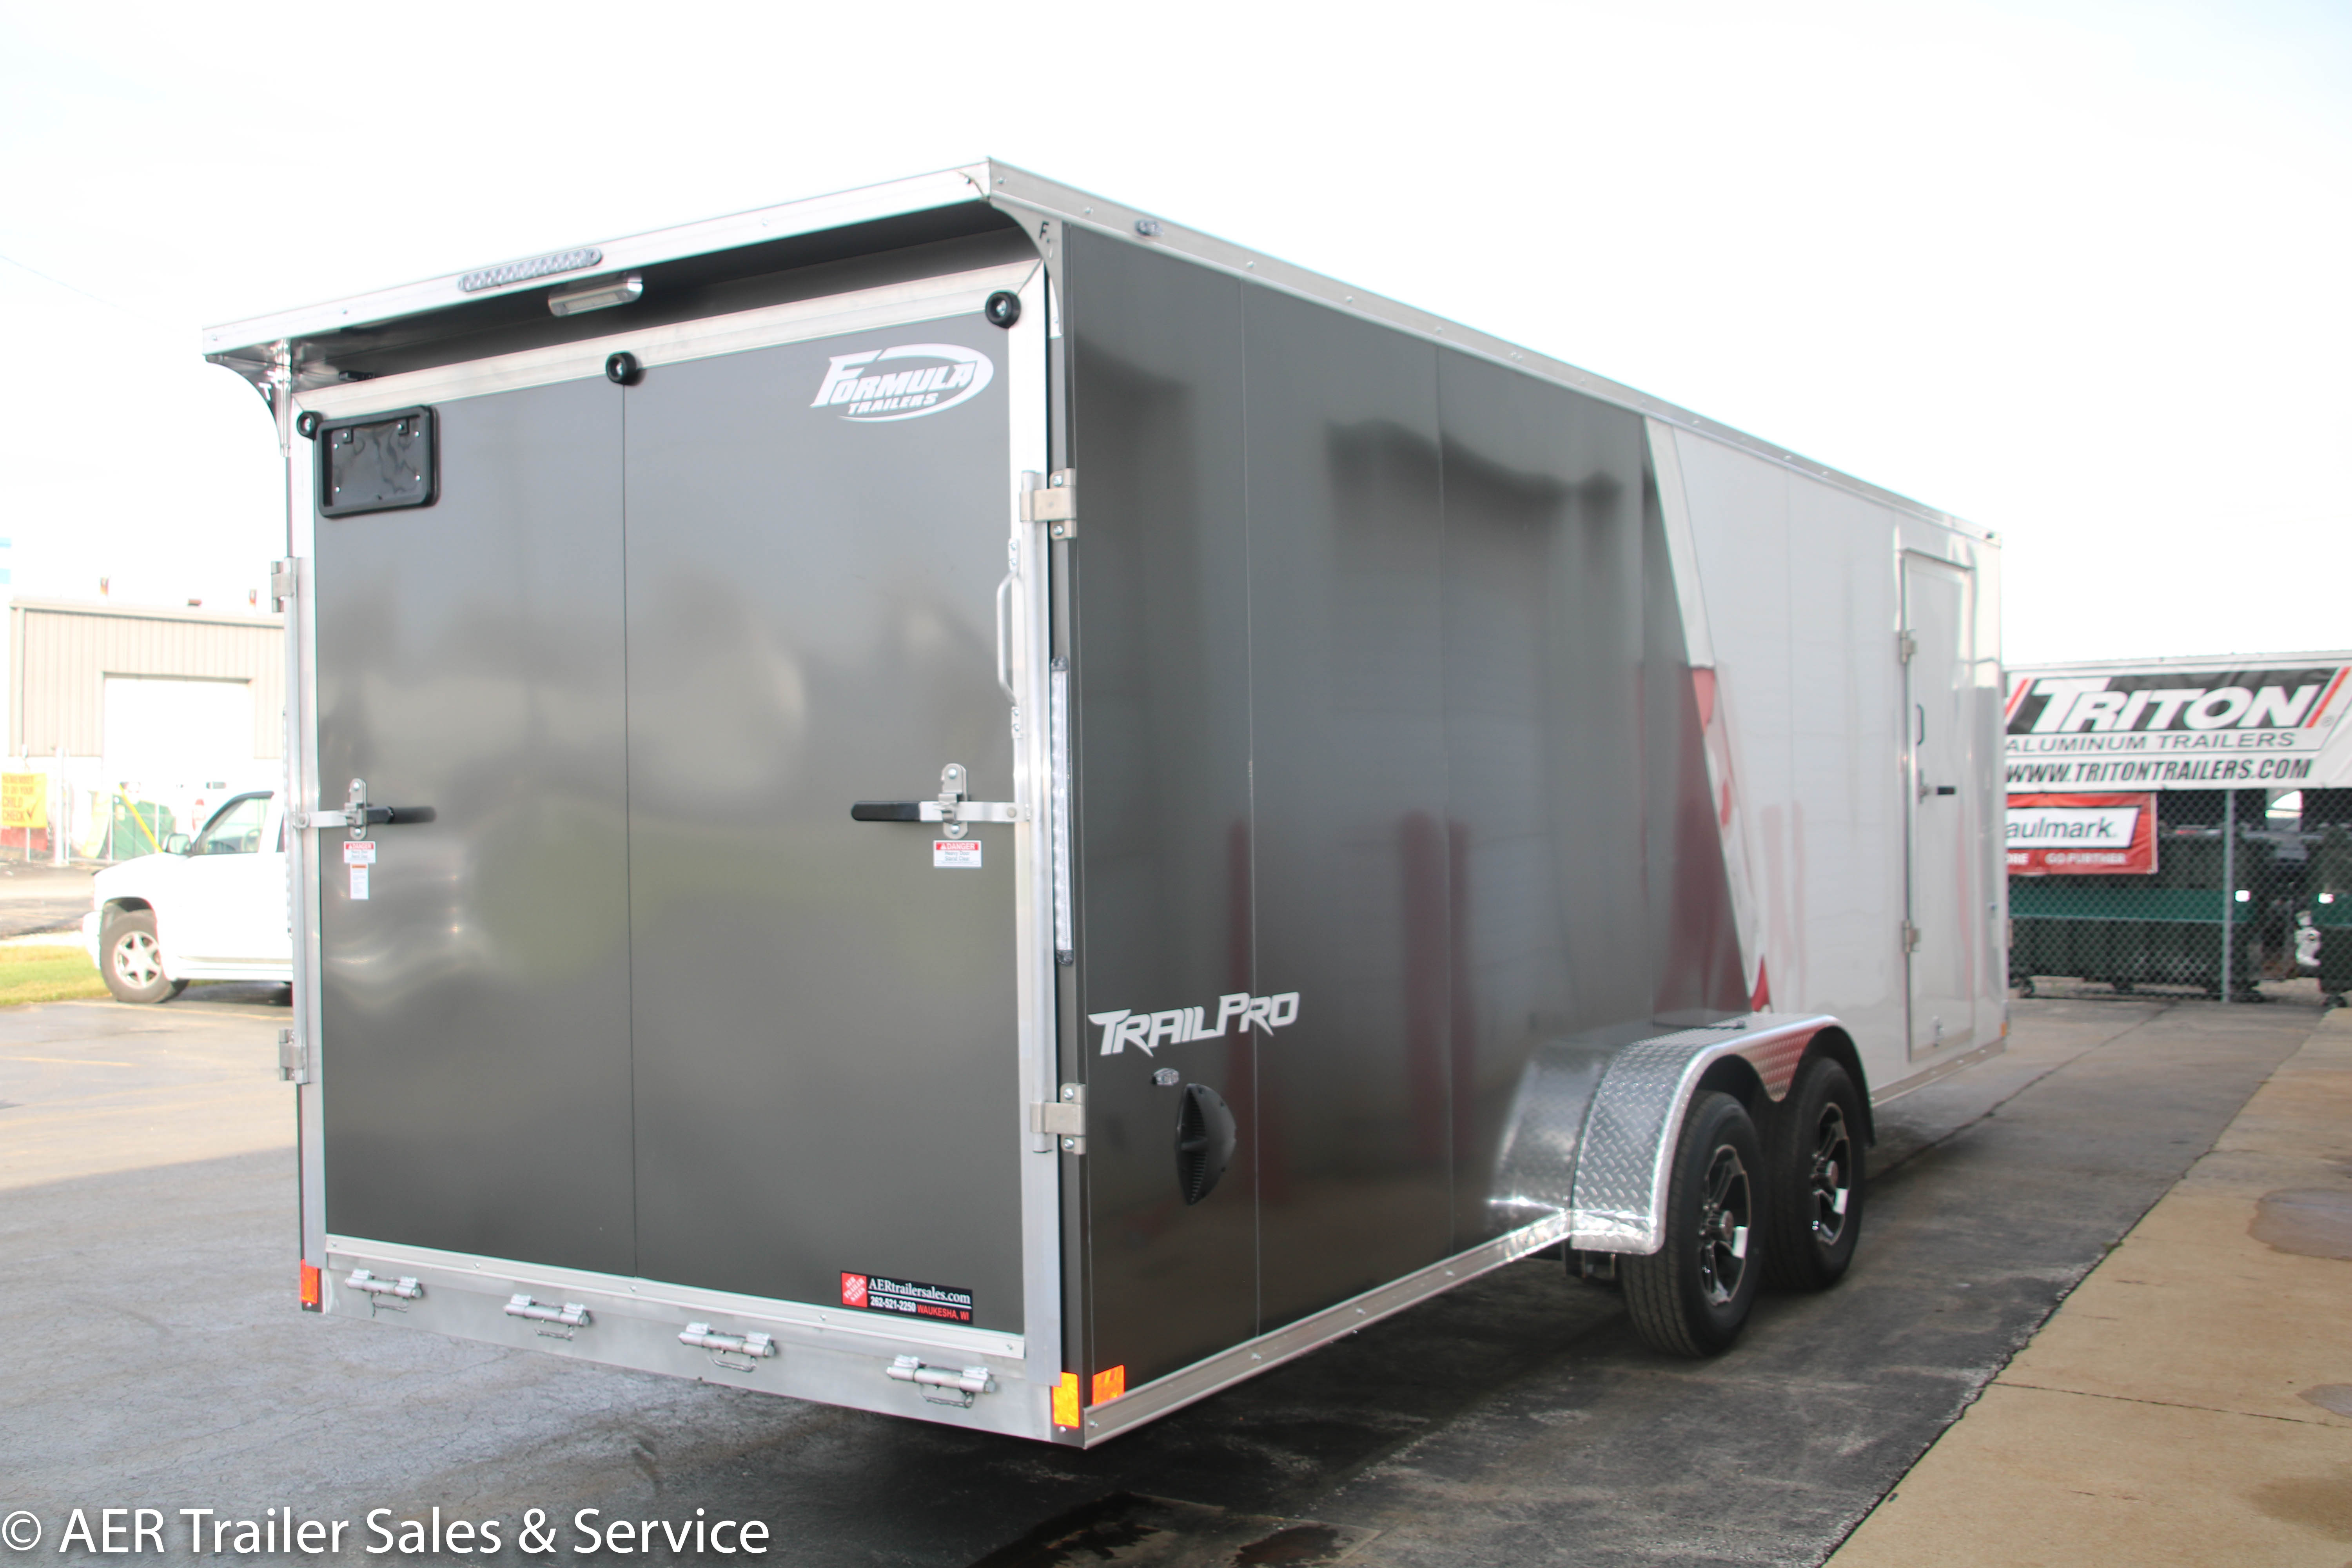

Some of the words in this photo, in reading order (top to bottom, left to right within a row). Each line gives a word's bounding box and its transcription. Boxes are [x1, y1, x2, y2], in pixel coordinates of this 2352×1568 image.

[809, 349, 977, 408] FORMULA
[848, 392, 939, 415] TRAILERS
[2029, 677, 2321, 733] TRITON
[2005, 735, 2147, 752] ALUMINUM
[2158, 732, 2296, 749] TRAILERS
[2004, 758, 2313, 782] WWW.TRITONTRAILERS.COM
[2005, 817, 2114, 838] aulmark
[868, 1278, 971, 1304] AERtrailersales.com
[870, 1296, 916, 1312] 262-521-2250
[917, 1305, 959, 1320] WAUKESHA,
[960, 1311, 969, 1321] WI
